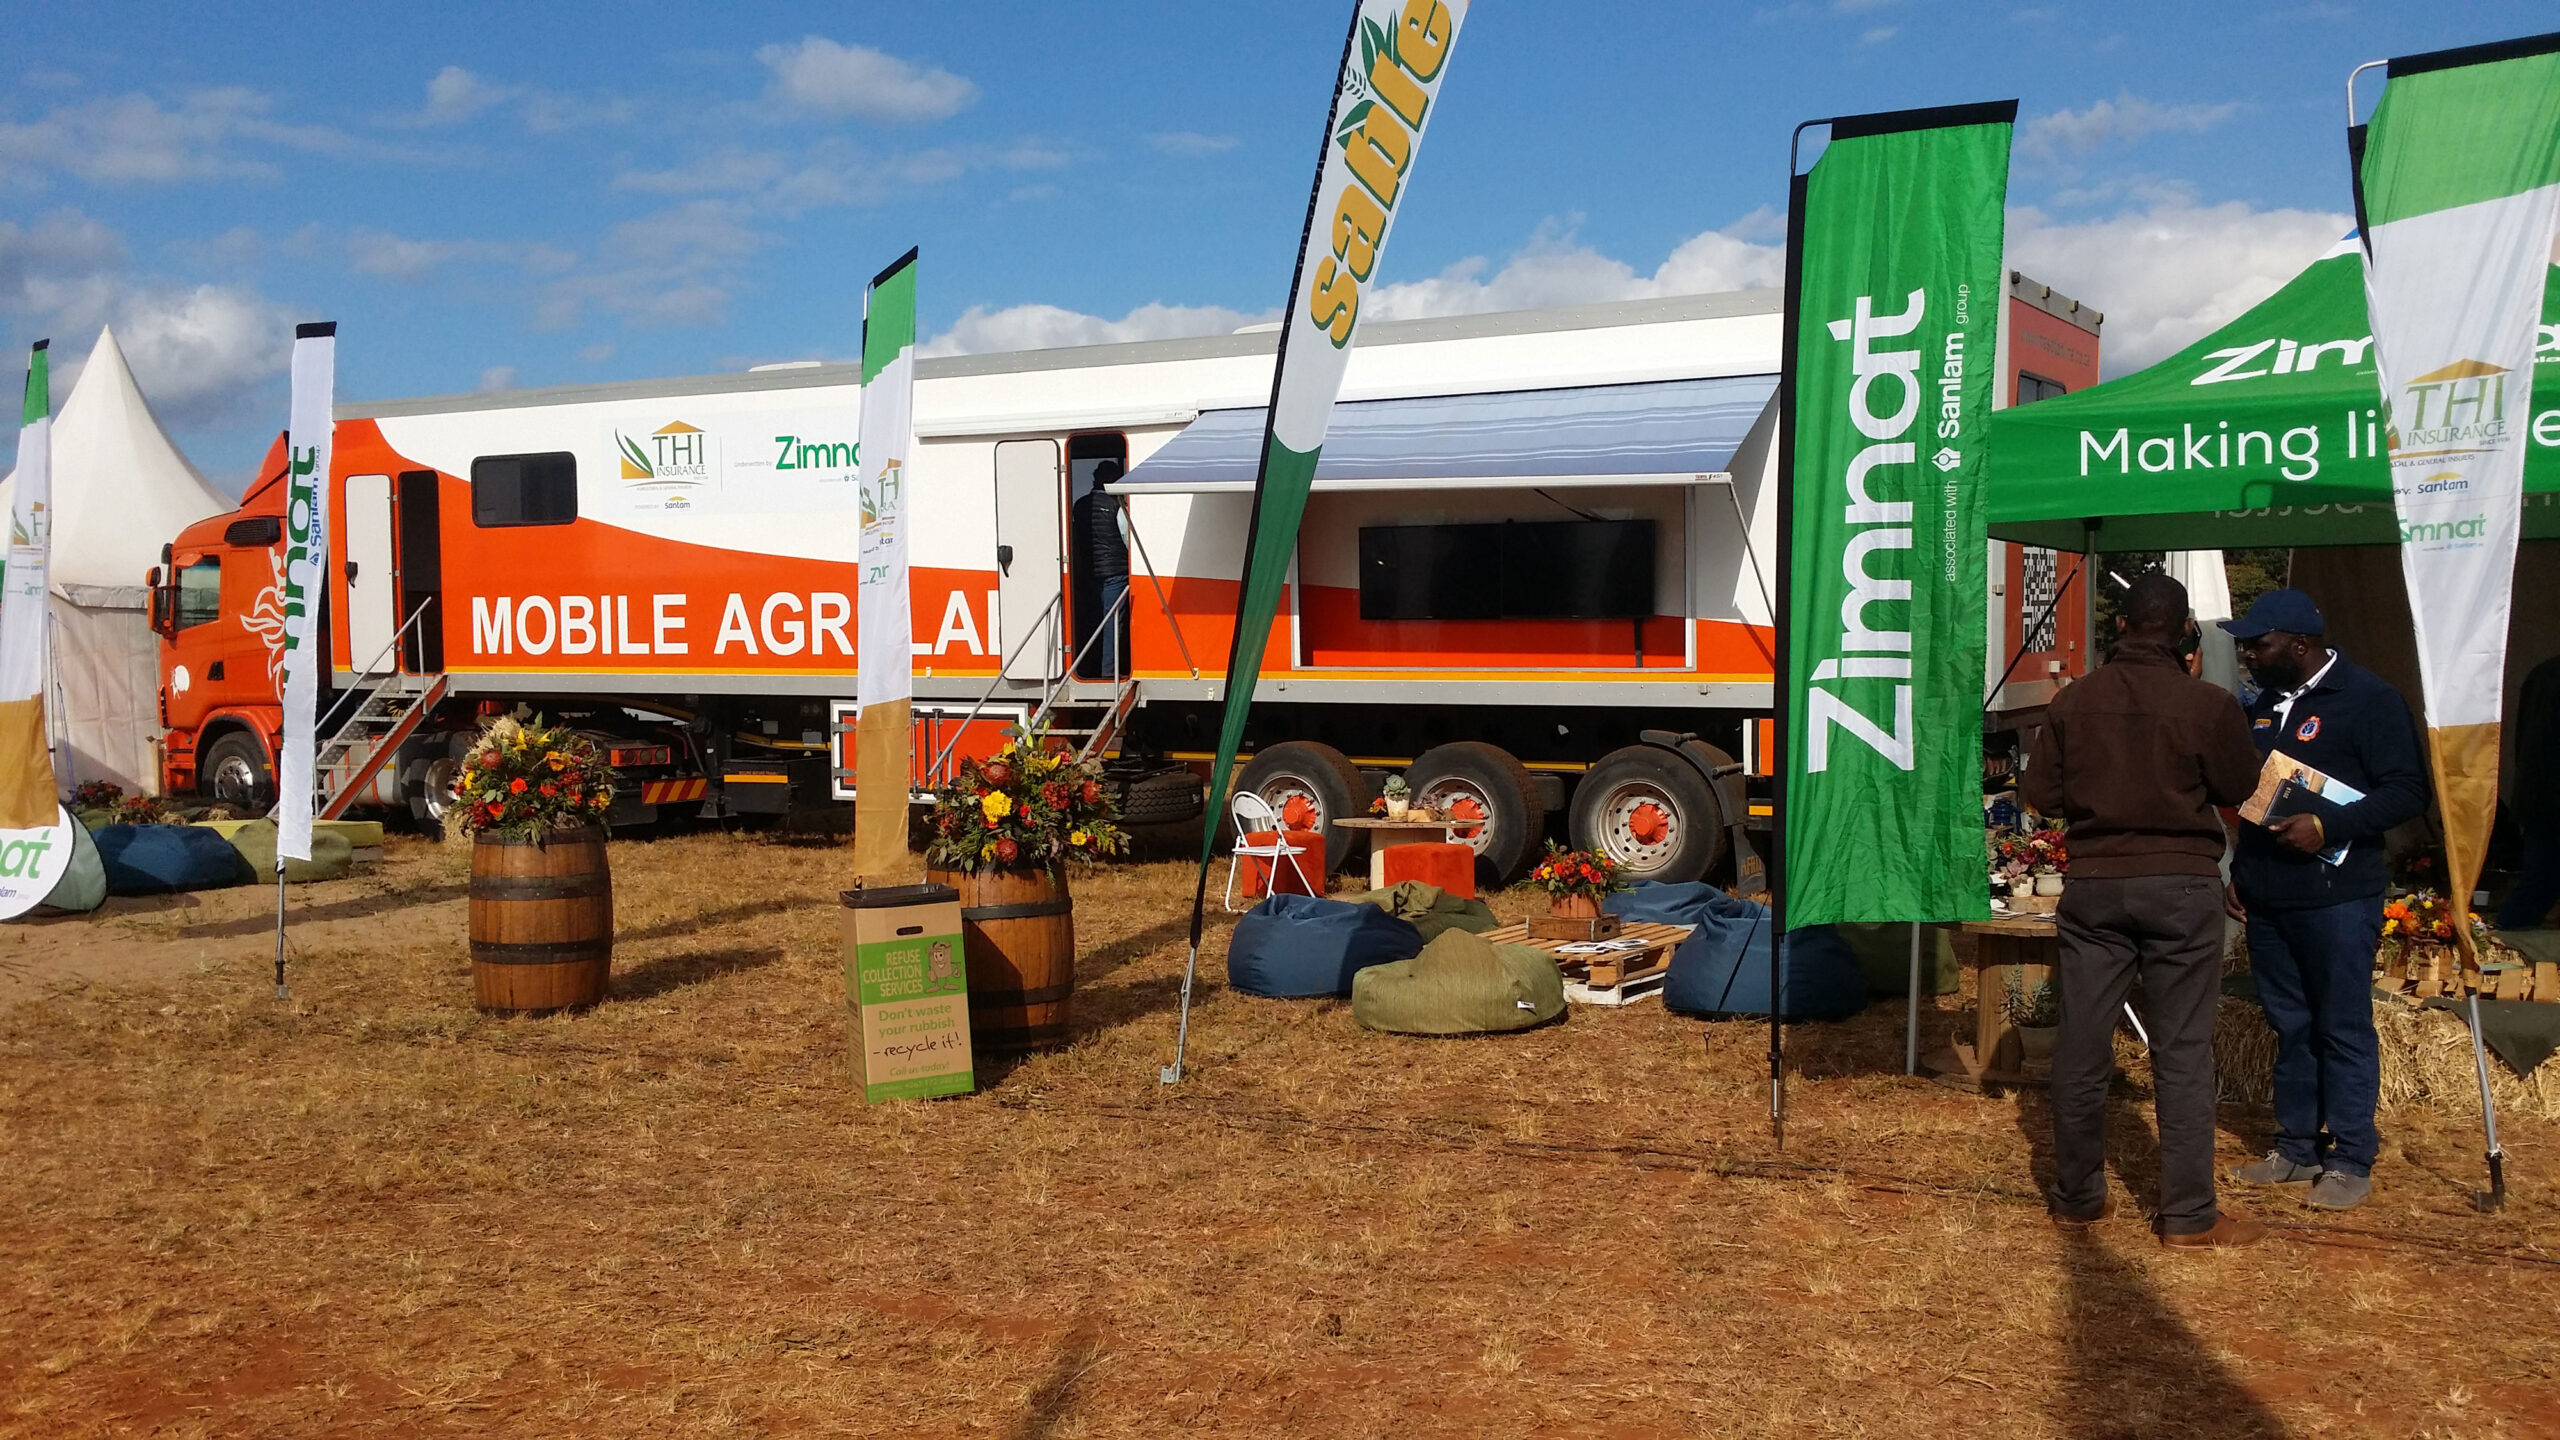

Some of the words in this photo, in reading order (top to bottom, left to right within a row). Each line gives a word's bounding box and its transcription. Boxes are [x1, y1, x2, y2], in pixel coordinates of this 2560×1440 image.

[1955, 284, 1970, 325] group
[1937, 332, 1965, 440] Sanlam
[2406, 374, 2507, 431] THI
[2407, 420, 2507, 447] INSURANCE
[652, 434, 704, 466] THI
[2080, 420, 2320, 481] Making
[656, 465, 706, 477] INSURANCE
[1947, 480, 1957, 506] with
[310, 477, 322, 548] Sanlam
[1808, 288, 1925, 774] Zimnat
[1945, 508, 1957, 581] associated
[472, 593, 688, 655] MOBILE
[714, 591, 856, 655] AGR
[886, 949, 921, 965] REFUSE
[863, 965, 922, 984] COLLECTION
[880, 979, 923, 997] SERVICES
[879, 1008, 912, 1021] Don't
[916, 1005, 951, 1017] waste
[879, 1026, 907, 1038] your
[910, 1017, 955, 1032] rubbish
[942, 1032, 962, 1049] it!
